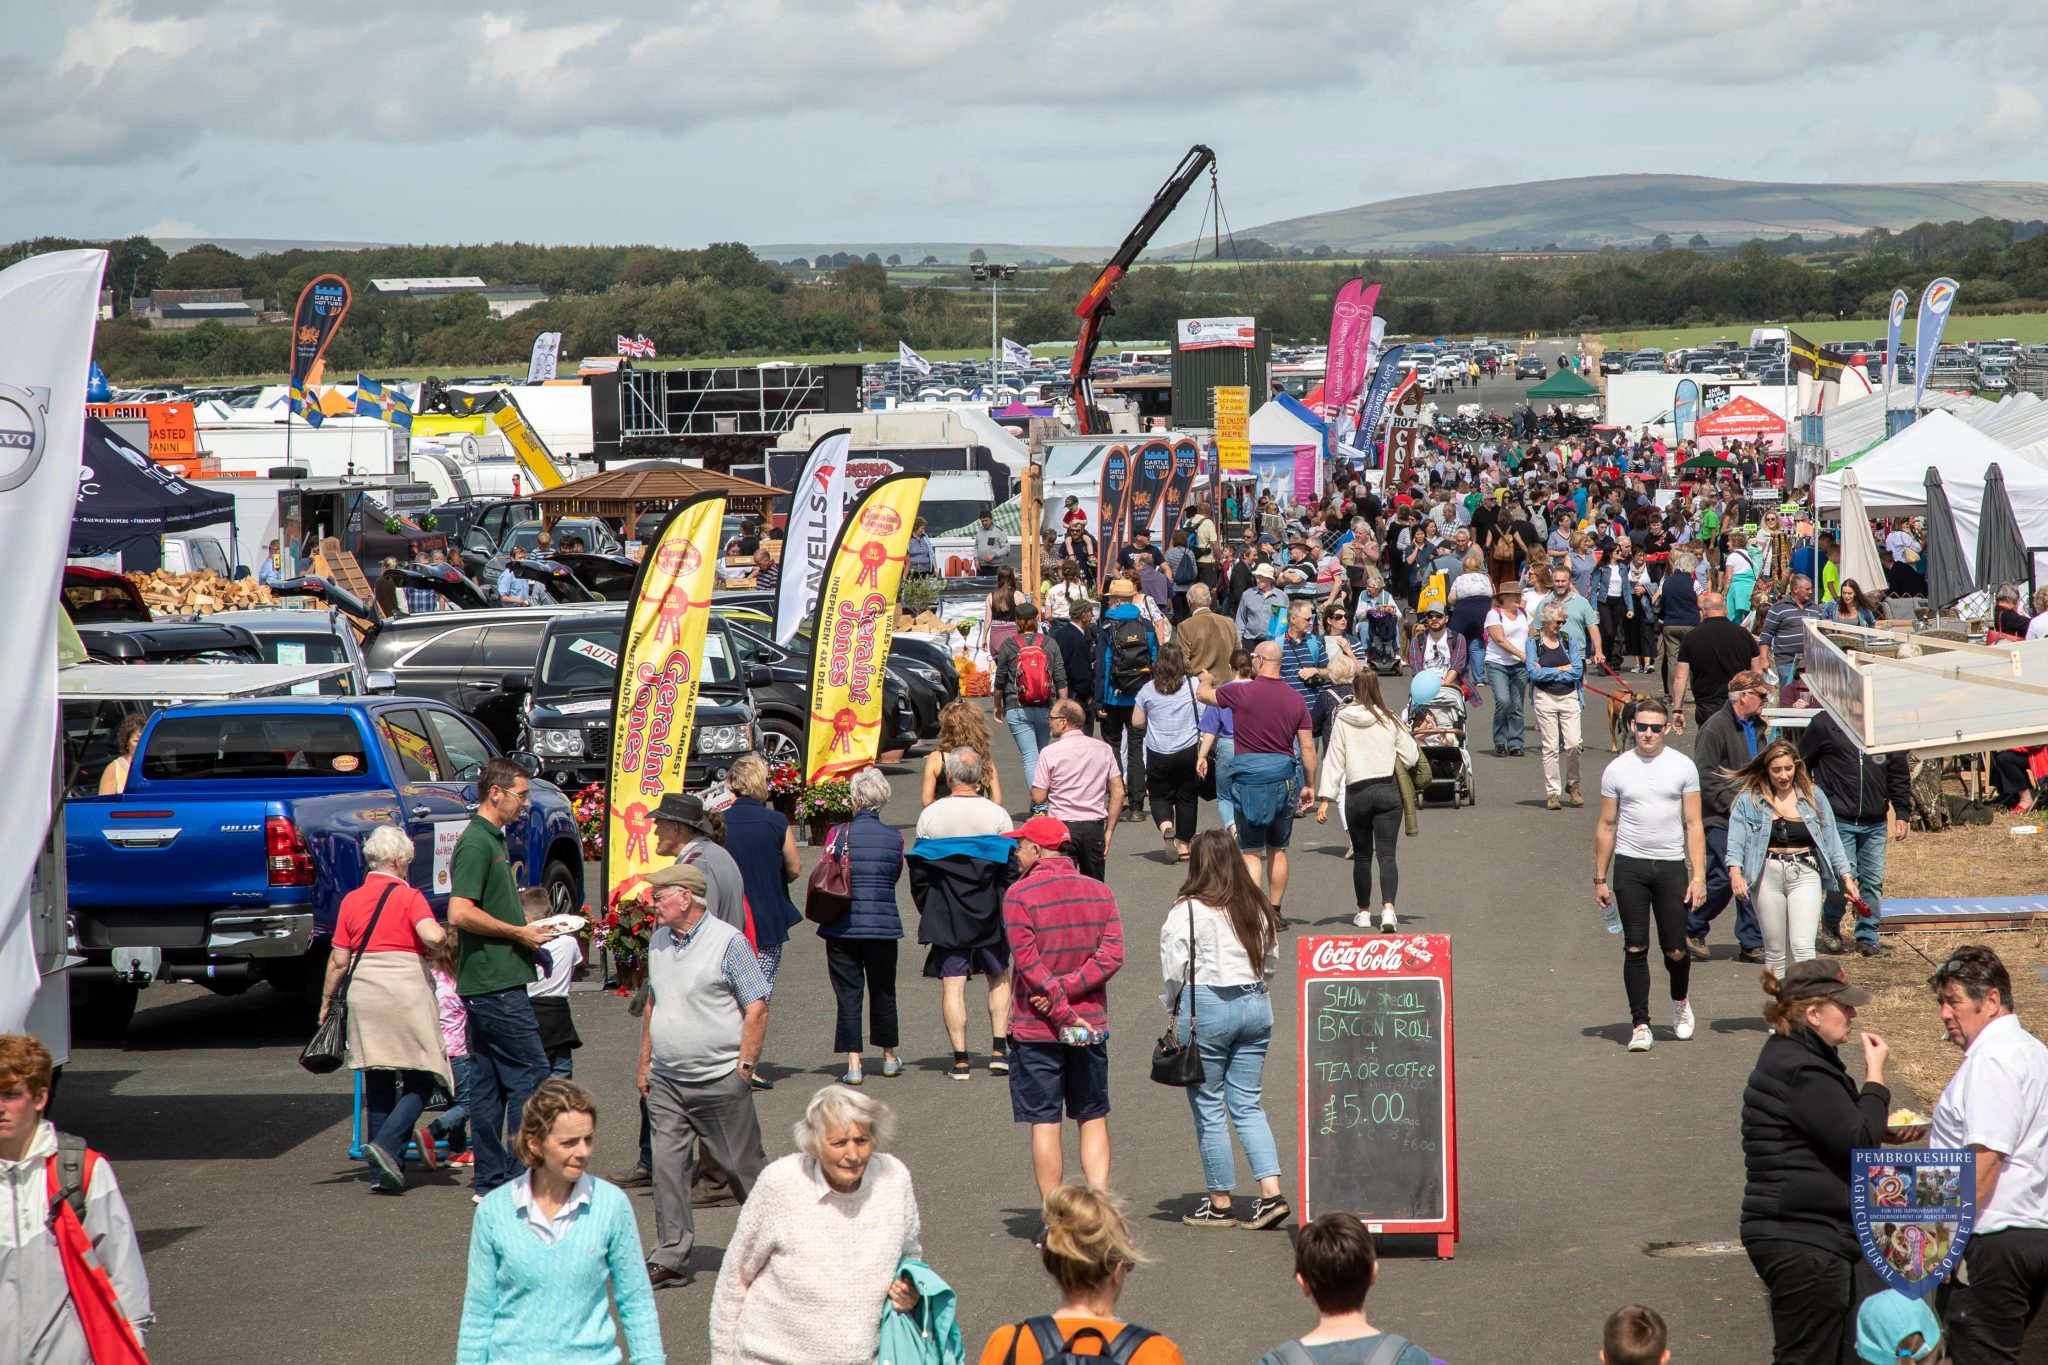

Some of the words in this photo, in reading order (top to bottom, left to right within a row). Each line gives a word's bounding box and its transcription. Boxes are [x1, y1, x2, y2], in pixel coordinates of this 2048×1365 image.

[1340, 320, 1348, 346] Products
[1336, 346, 1345, 368] Health
[1380, 364, 1395, 387] Day's
[1227, 417, 1248, 425] UNLOCK
[1393, 417, 1418, 427] HOT
[666, 595, 676, 603] 50
[822, 576, 840, 647] INDEPENDENT
[829, 601, 861, 687] Jones
[849, 593, 886, 705] Geraint
[621, 631, 641, 720] INDEPENDENT
[684, 680, 696, 723] WALES'
[815, 671, 826, 710] DEALER
[622, 662, 663, 773] Jones
[640, 650, 690, 796] Geraint
[672, 725, 688, 778] LARGEST
[220, 824, 261, 833] HILUX
[447, 833, 455, 841] Can
[1312, 939, 1406, 972] Coca-Cola
[1324, 984, 1369, 1008] SHOW
[1318, 1015, 1384, 1041] BACON
[1394, 1018, 1432, 1039] ROLL
[1365, 1041, 1378, 1054] +
[1315, 1061, 1352, 1082] TEA
[1357, 1062, 1380, 1080] OR
